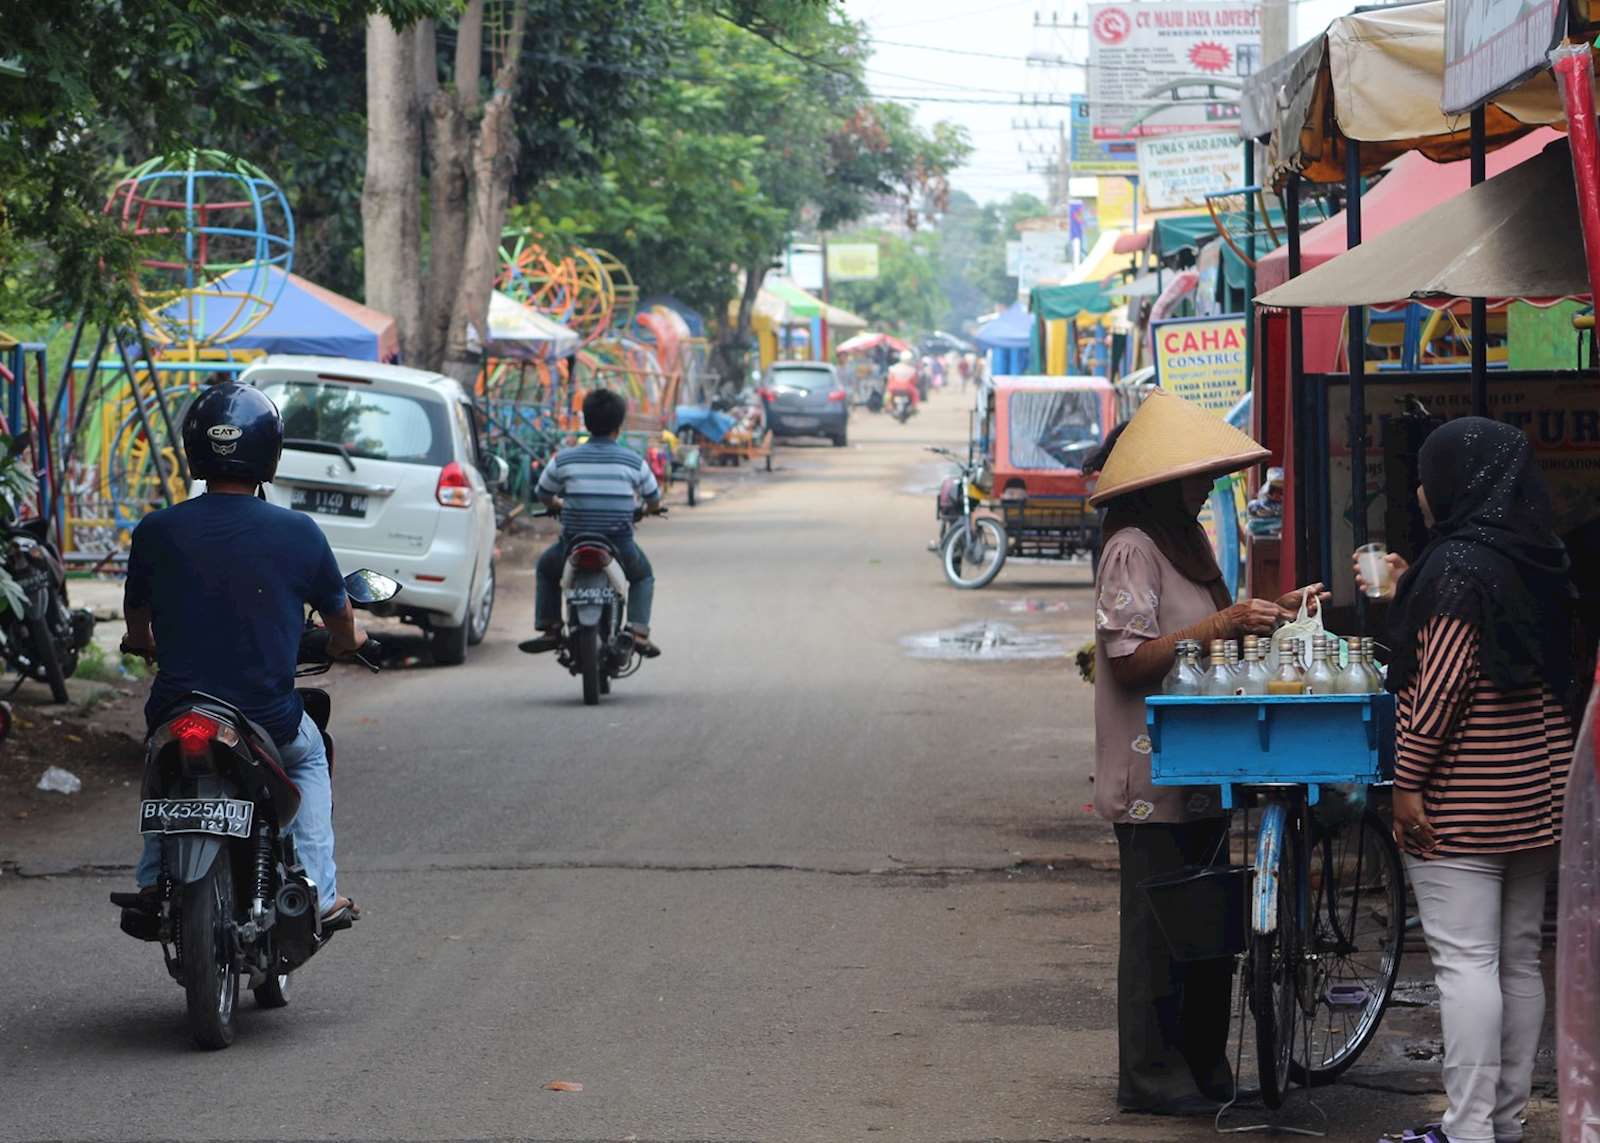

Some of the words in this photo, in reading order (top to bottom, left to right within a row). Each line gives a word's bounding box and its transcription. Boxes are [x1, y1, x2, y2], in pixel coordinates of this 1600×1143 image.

[1187, 10, 1211, 27] JAYA
[1147, 141, 1185, 156] TUNAS
[1174, 382, 1200, 392] TENDA
[1204, 399, 1237, 409] TERATA
[212, 428, 235, 436] CAT
